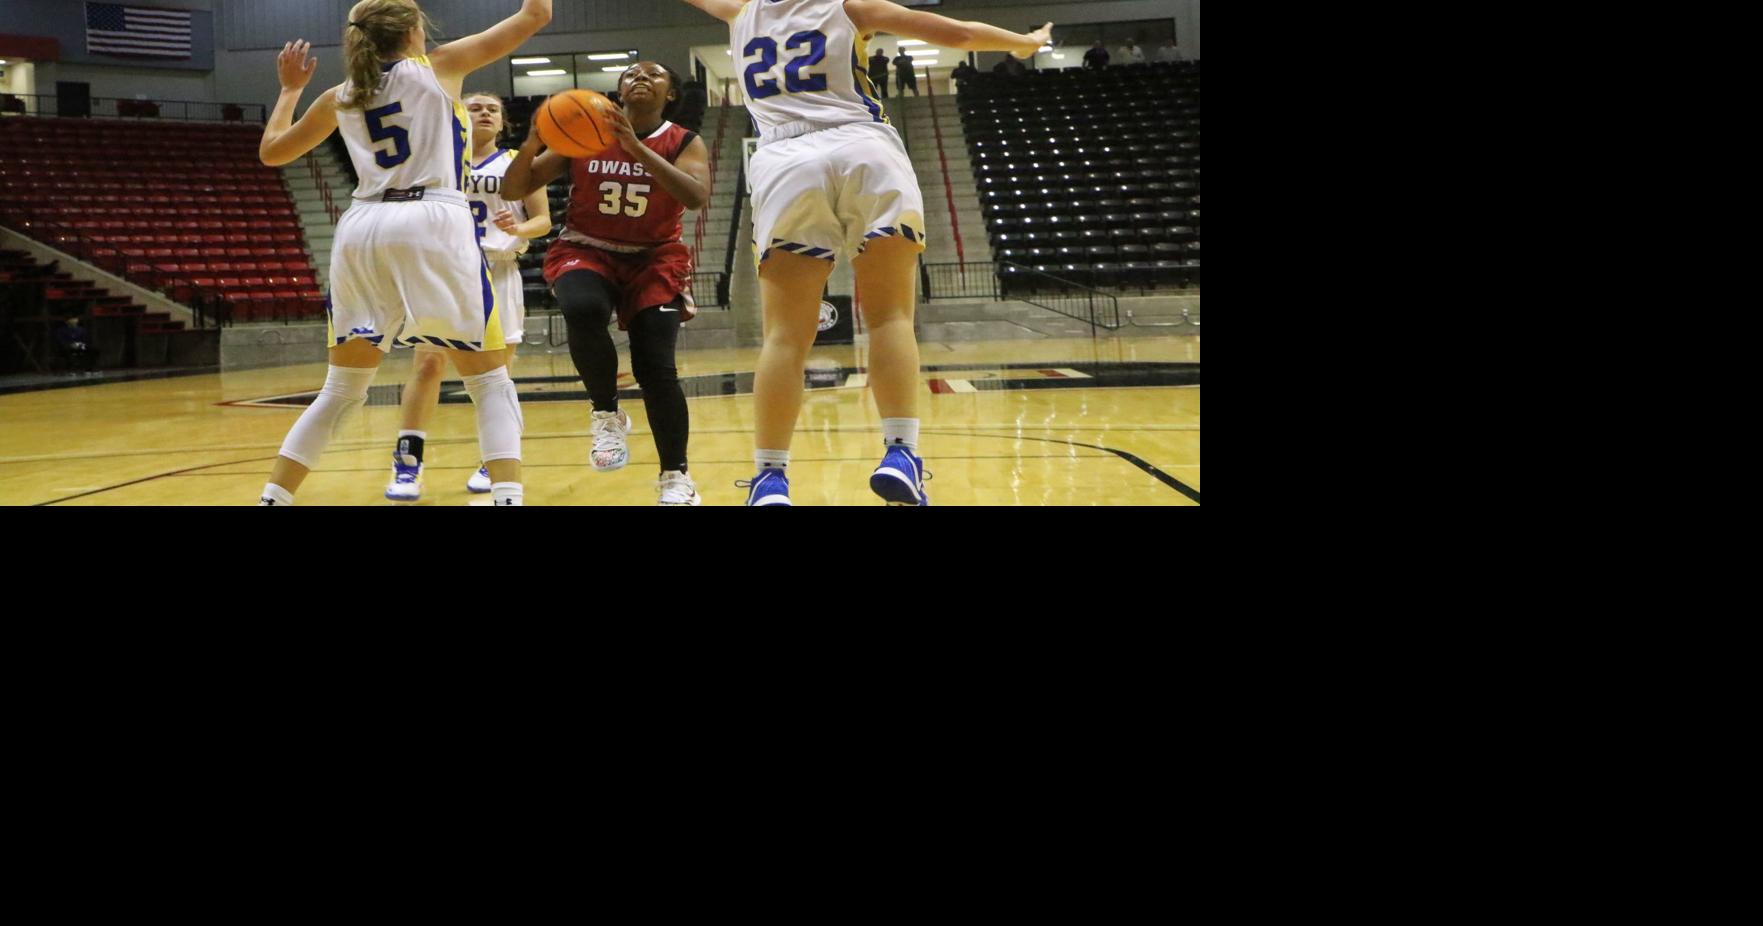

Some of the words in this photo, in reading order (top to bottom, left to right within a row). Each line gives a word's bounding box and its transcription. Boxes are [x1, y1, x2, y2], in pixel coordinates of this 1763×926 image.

[743, 29, 827, 101] 22
[364, 101, 411, 169] 5
[588, 160, 653, 177] OWAS
[598, 181, 651, 218] 35
